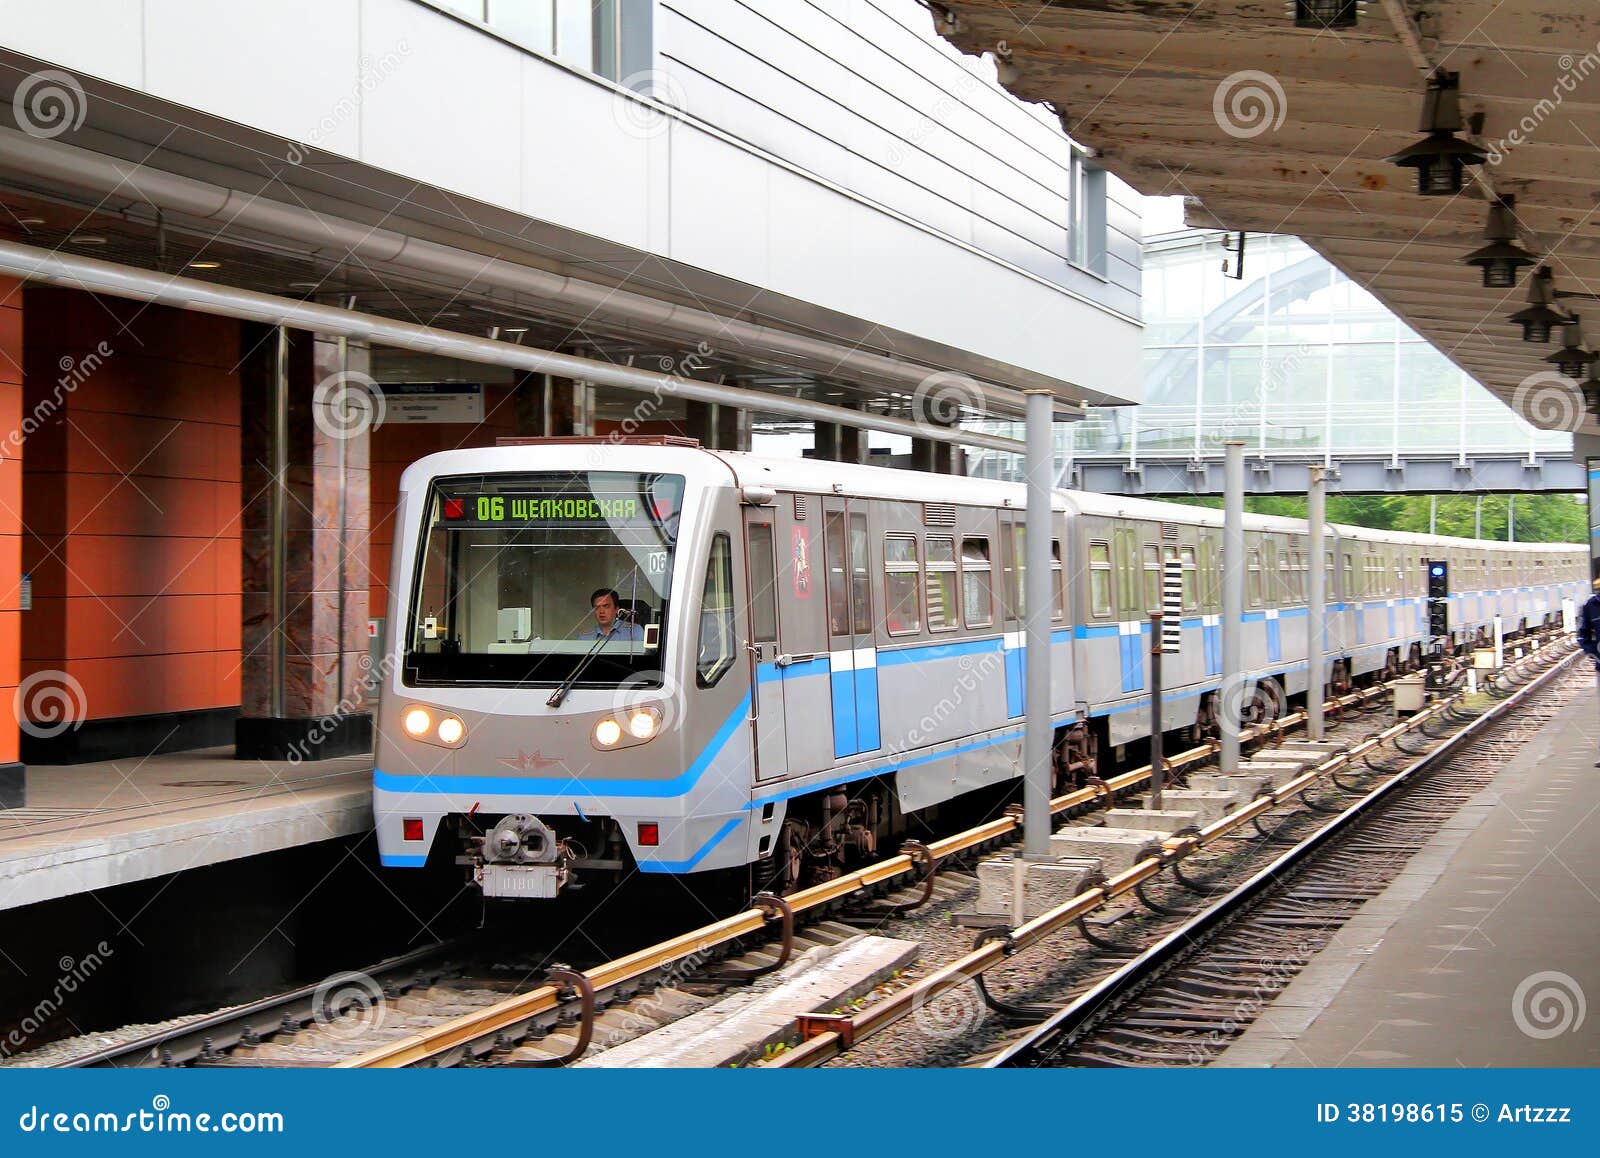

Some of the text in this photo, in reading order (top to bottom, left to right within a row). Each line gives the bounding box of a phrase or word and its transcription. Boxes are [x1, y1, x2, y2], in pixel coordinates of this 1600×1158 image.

[477, 497, 636, 520] 06 ЩЕЛКОВСКАЯ
[650, 554, 665, 571] 06
